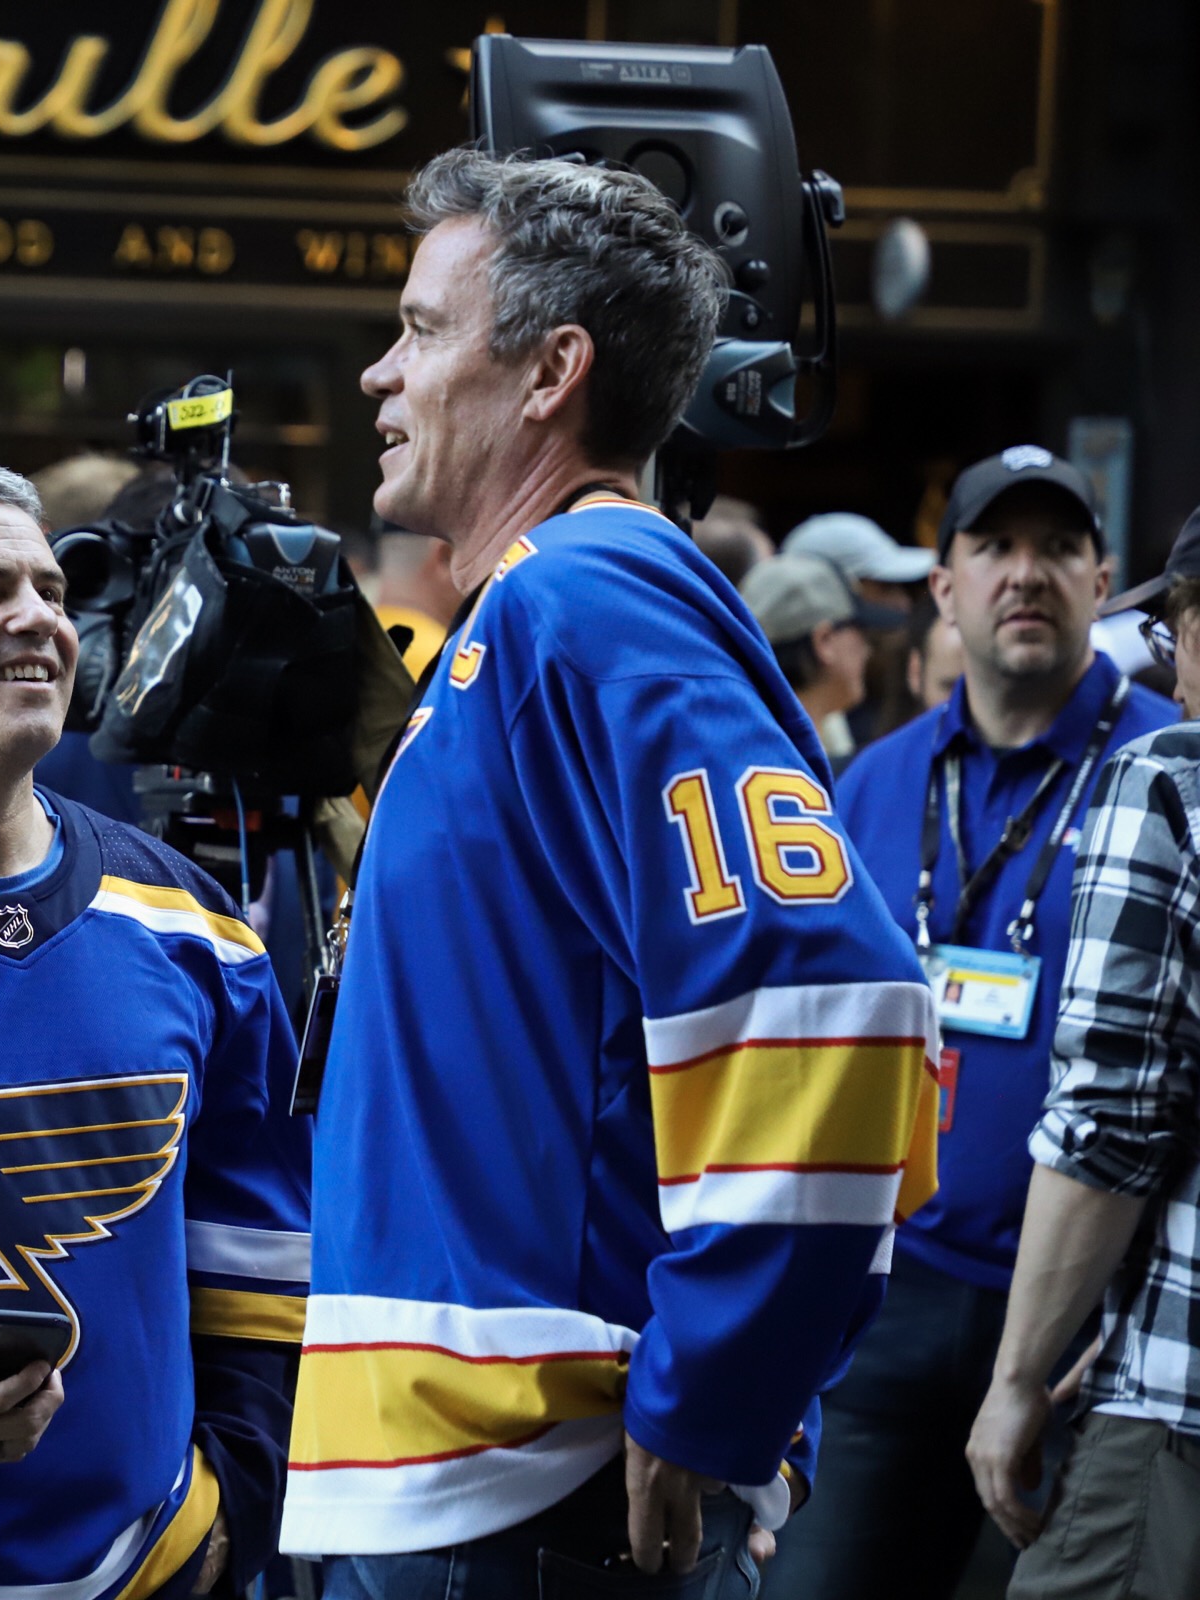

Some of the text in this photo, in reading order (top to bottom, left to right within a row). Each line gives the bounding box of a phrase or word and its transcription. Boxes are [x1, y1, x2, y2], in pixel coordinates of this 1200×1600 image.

[113, 222, 236, 276] AND
[296, 228, 422, 279] WIN
[661, 765, 854, 926] 16
[3, 916, 23, 940] NHL
